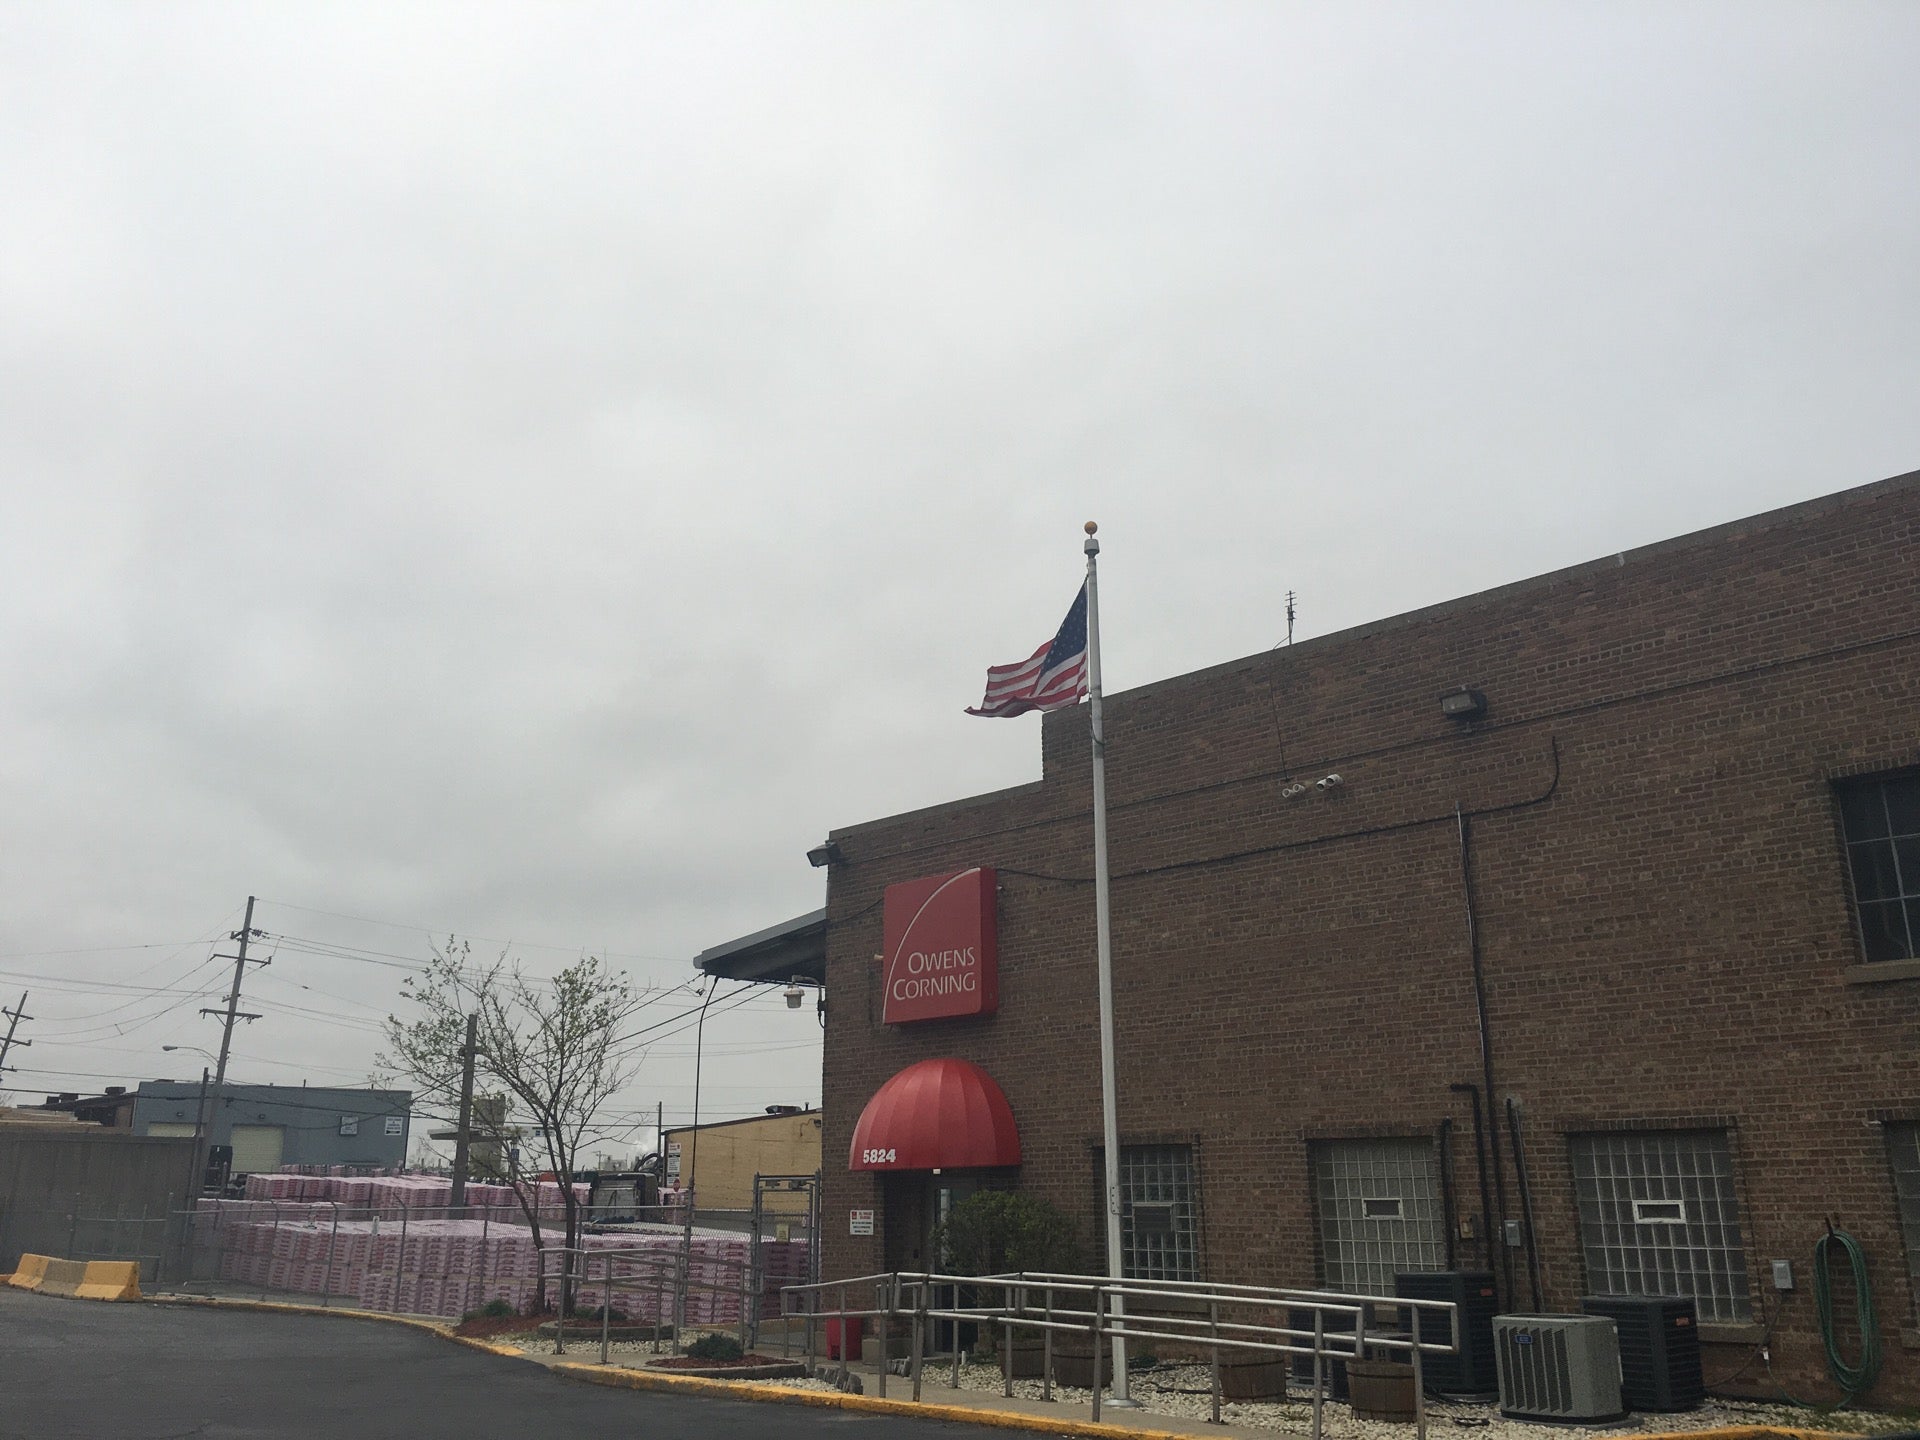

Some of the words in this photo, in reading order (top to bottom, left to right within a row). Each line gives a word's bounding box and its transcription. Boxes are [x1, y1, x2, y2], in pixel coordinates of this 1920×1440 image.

[908, 947, 975, 974] OWENS
[893, 972, 976, 1000] CORNING
[863, 1148, 897, 1164] 5824
